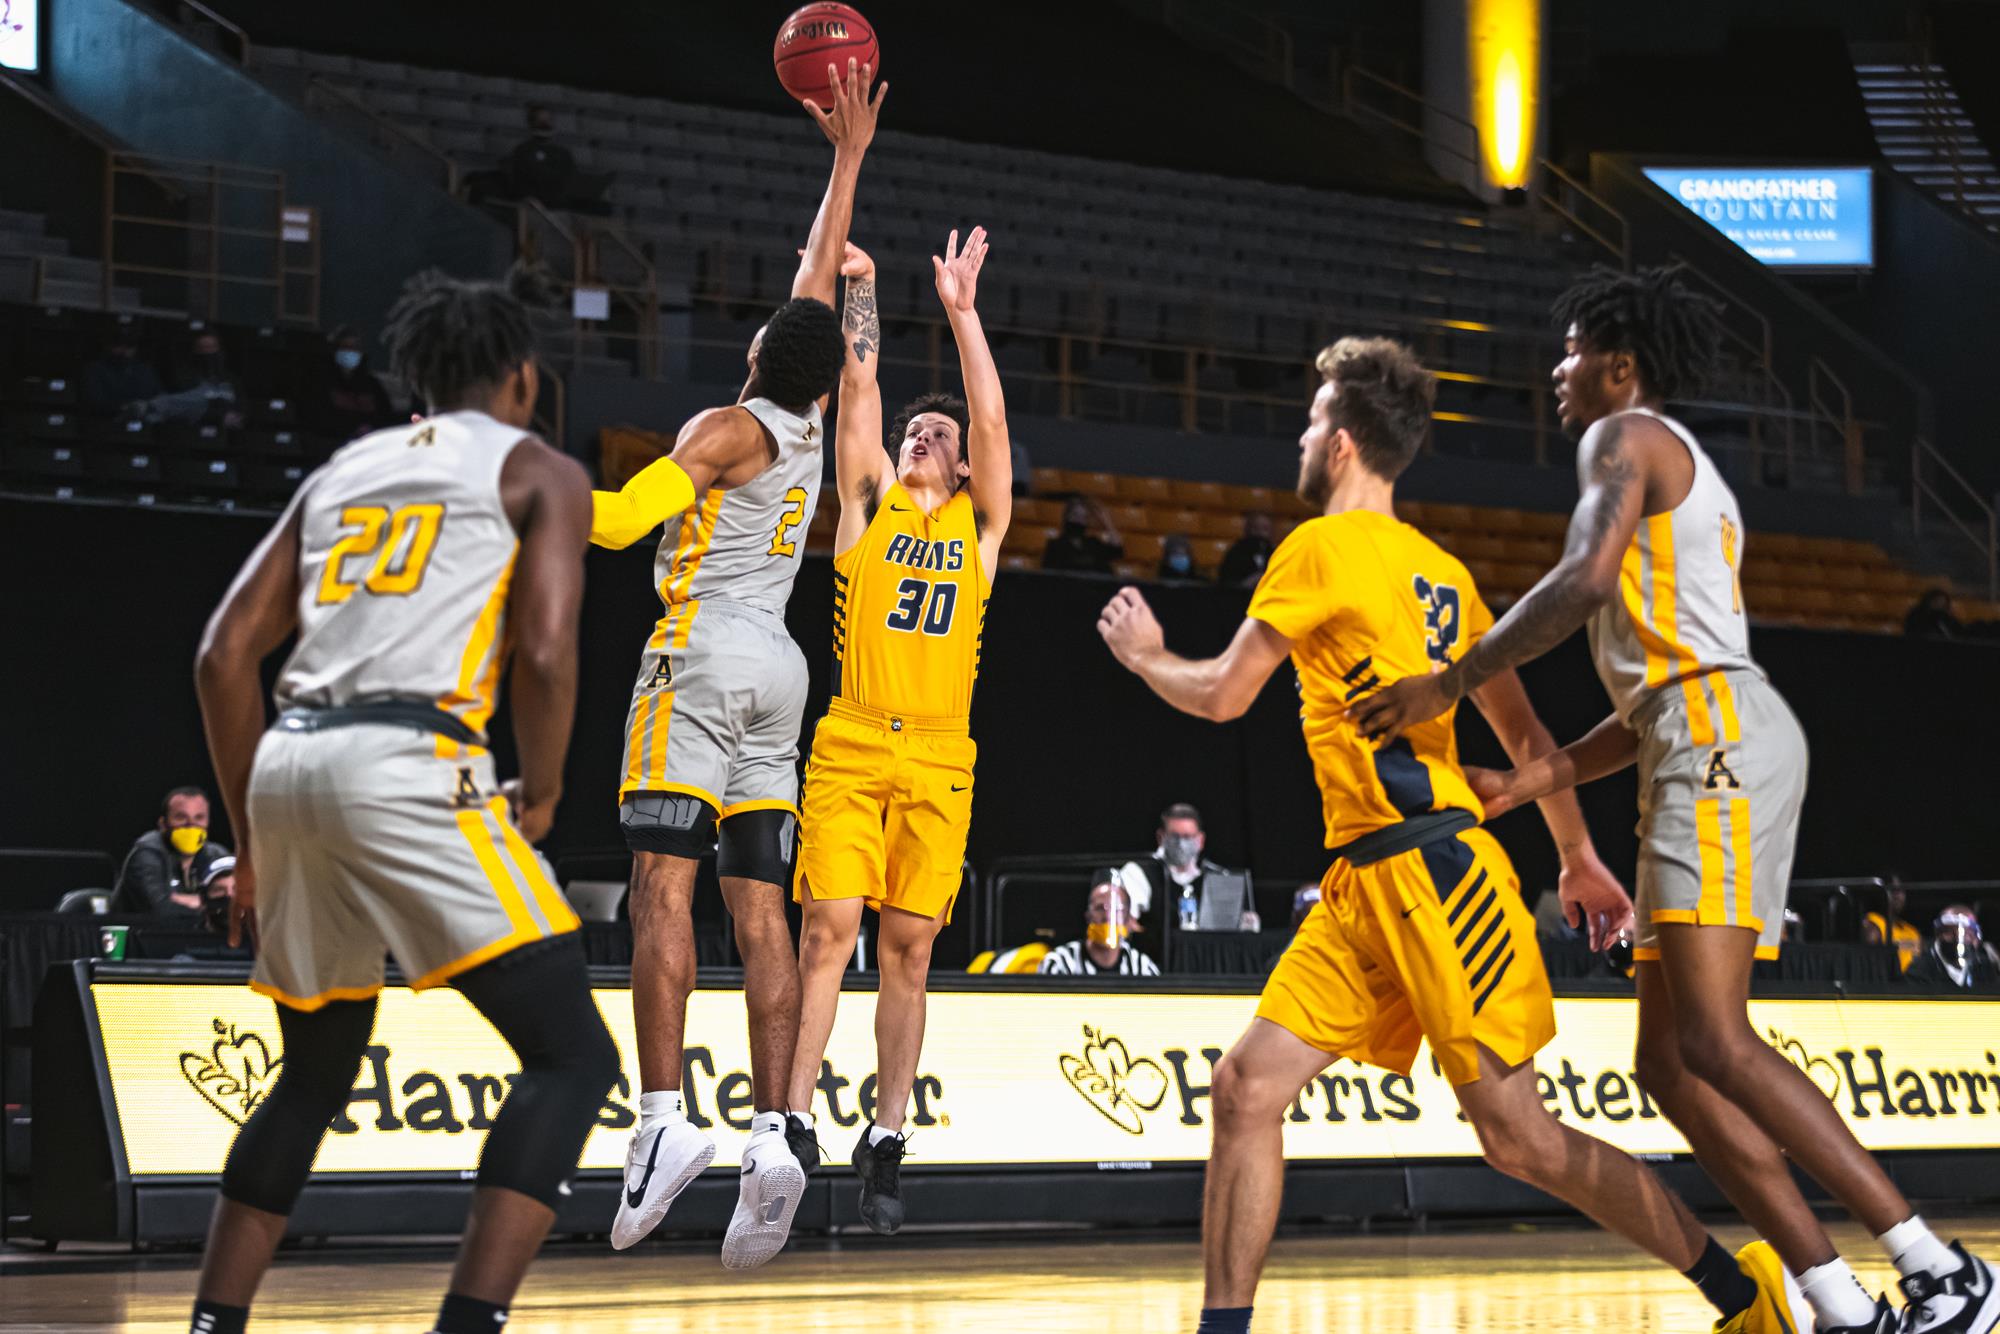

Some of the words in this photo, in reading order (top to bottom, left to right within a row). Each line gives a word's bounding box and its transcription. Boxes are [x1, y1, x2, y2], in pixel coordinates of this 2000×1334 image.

[1679, 179, 1837, 201] GRANDFATHER
[767, 486, 808, 558] 2
[315, 502, 446, 607] 20
[884, 533, 964, 572] RAMS
[886, 577, 958, 637] 30
[646, 653, 673, 688] A
[452, 767, 483, 808] A
[1704, 749, 1740, 789] A
[329, 1045, 636, 1133] Hars
